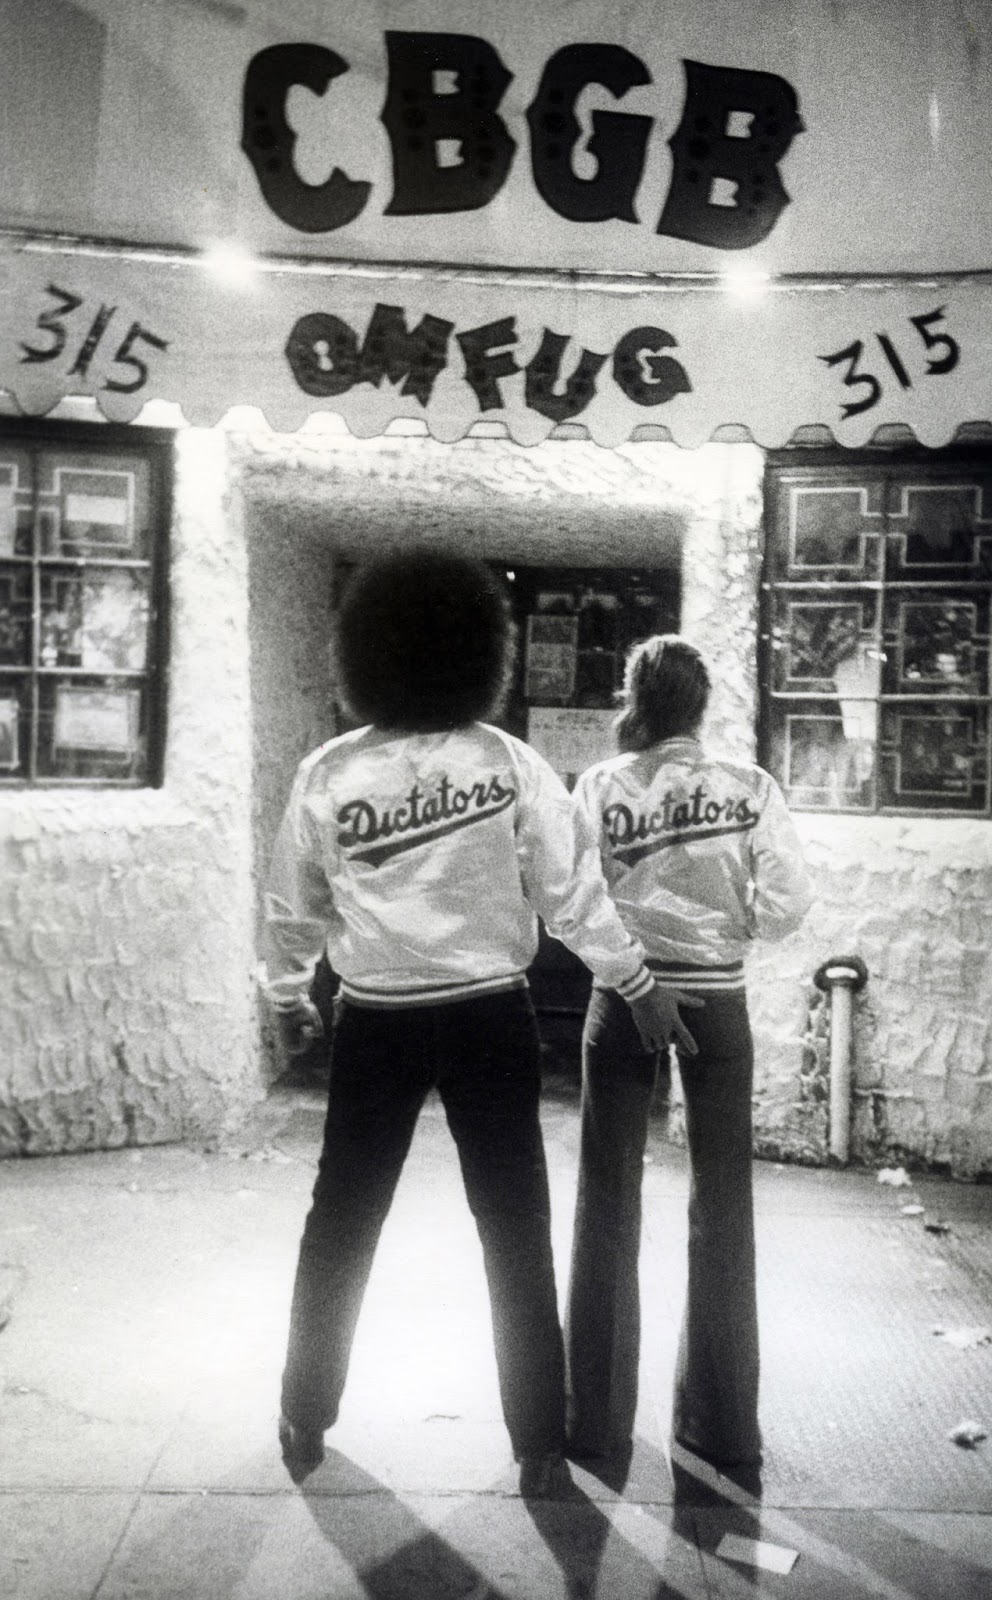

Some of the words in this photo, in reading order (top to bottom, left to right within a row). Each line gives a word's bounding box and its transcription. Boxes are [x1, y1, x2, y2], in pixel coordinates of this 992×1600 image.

[241, 30, 806, 250] CBGB
[19, 285, 168, 394] 315
[285, 303, 692, 422] OMFUG
[819, 307, 961, 420] 315
[337, 774, 516, 848] Dictators
[602, 784, 759, 848] Dictators
